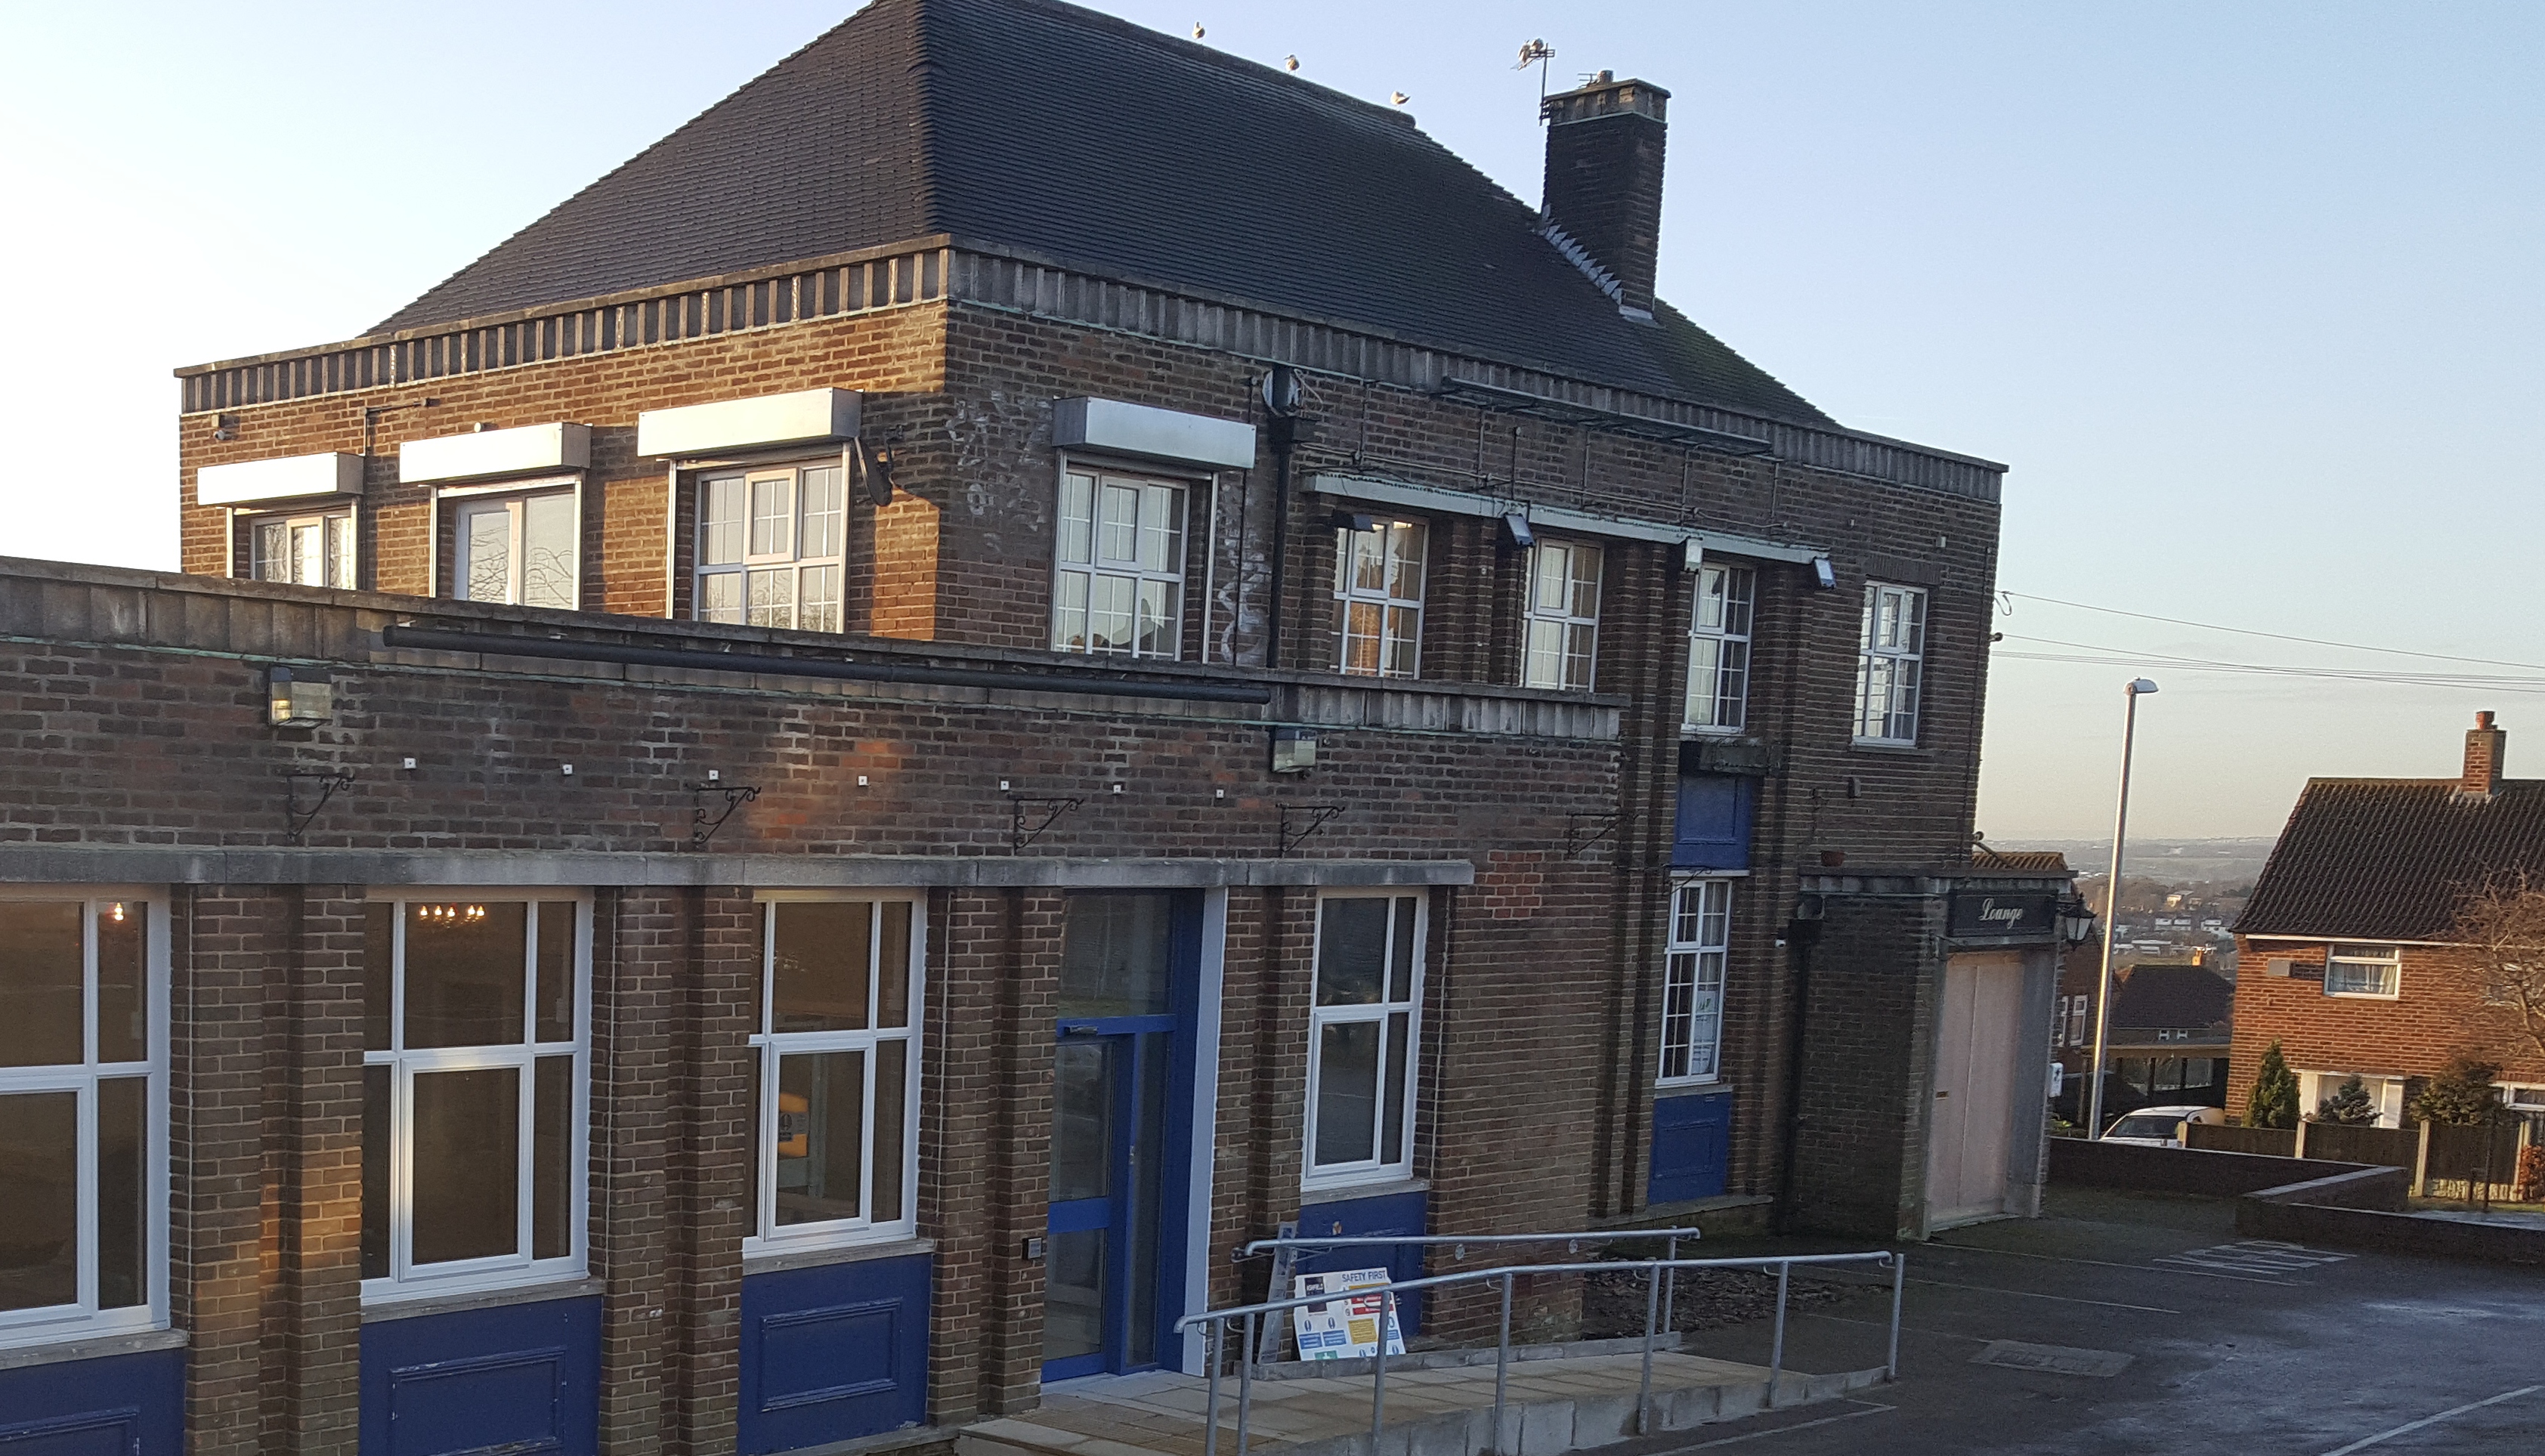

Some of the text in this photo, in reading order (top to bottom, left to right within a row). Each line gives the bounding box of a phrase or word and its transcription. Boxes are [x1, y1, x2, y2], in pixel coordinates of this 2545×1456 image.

[1979, 898, 2023, 929] Lounge
[1342, 1270, 1386, 1282] SAFETY FIRST
